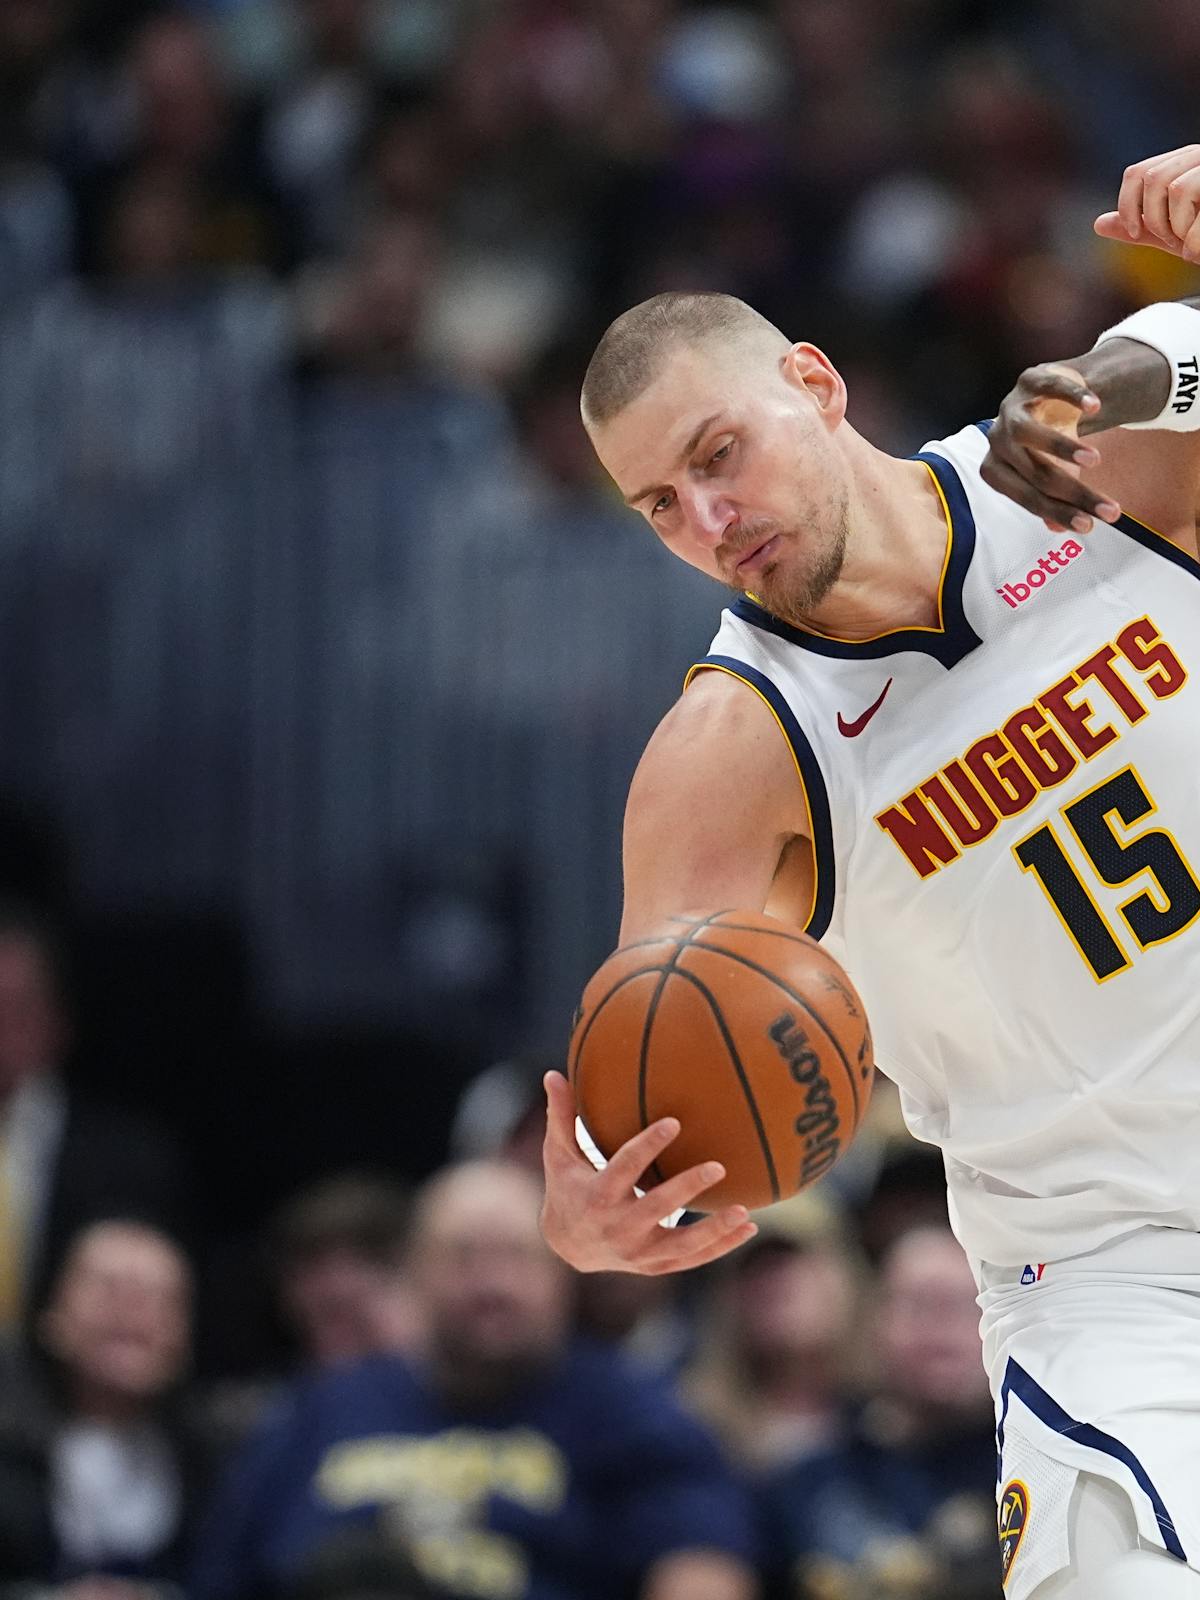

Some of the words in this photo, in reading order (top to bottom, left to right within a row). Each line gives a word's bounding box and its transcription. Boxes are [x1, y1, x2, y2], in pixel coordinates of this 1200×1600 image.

[1171, 355, 1199, 414] TAYP
[995, 538, 1084, 609] ibotta
[872, 613, 1189, 881] NUGGETS
[768, 1012, 841, 1190] Wilson
